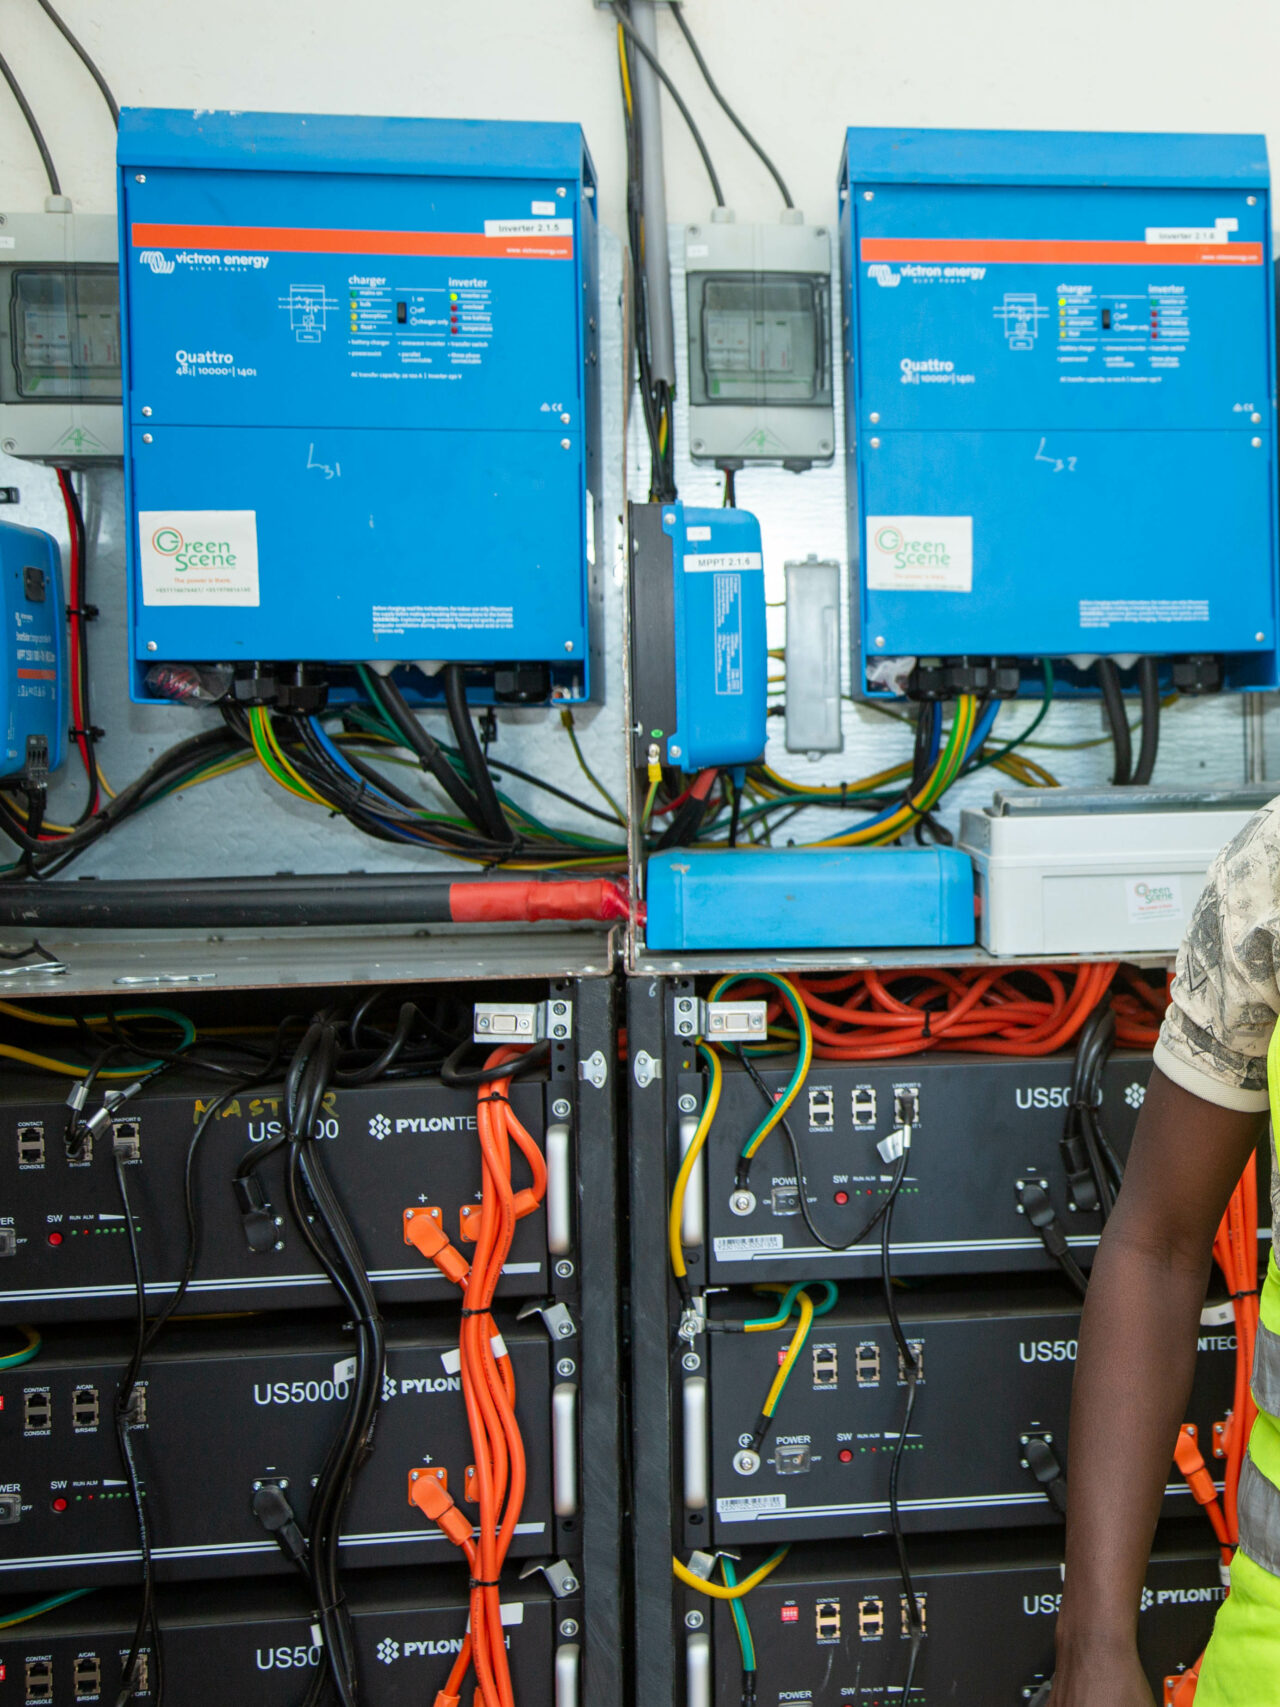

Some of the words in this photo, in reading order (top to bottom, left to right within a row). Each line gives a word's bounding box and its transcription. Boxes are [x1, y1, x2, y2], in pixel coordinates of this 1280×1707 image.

[176, 251, 220, 264] victron
[223, 255, 270, 269] energy
[900, 264, 942, 277] victron
[943, 267, 987, 280] energy
[348, 275, 387, 288] charger
[448, 277, 488, 288] inverter
[175, 350, 234, 366] Quattro
[900, 358, 954, 373] Quattro
[156, 530, 231, 553] Green
[878, 529, 946, 552] Green
[175, 553, 237, 572] Scene
[698, 558, 726, 567] MPPT
[893, 552, 951, 570] Scene
[192, 1092, 340, 1125] MASTR
[395, 1115, 478, 1134] PYLONTE
[833, 1175, 849, 1184] SW
[47, 1215, 63, 1223] SW
[1019, 1339, 1079, 1363] US50
[23, 1386, 51, 1394] CONTACT
[253, 1379, 350, 1405] US5000
[400, 1377, 461, 1394] PYLON
[24, 1429, 51, 1437] CONSOLE
[776, 1435, 811, 1445] POWER
[836, 1432, 853, 1442] SW
[50, 1480, 68, 1489] SW
[256, 1646, 322, 1670] US50
[778, 1690, 812, 1700] POWER
[840, 1687, 856, 1696] SW
[25, 1698, 53, 1706] CONSOLE
